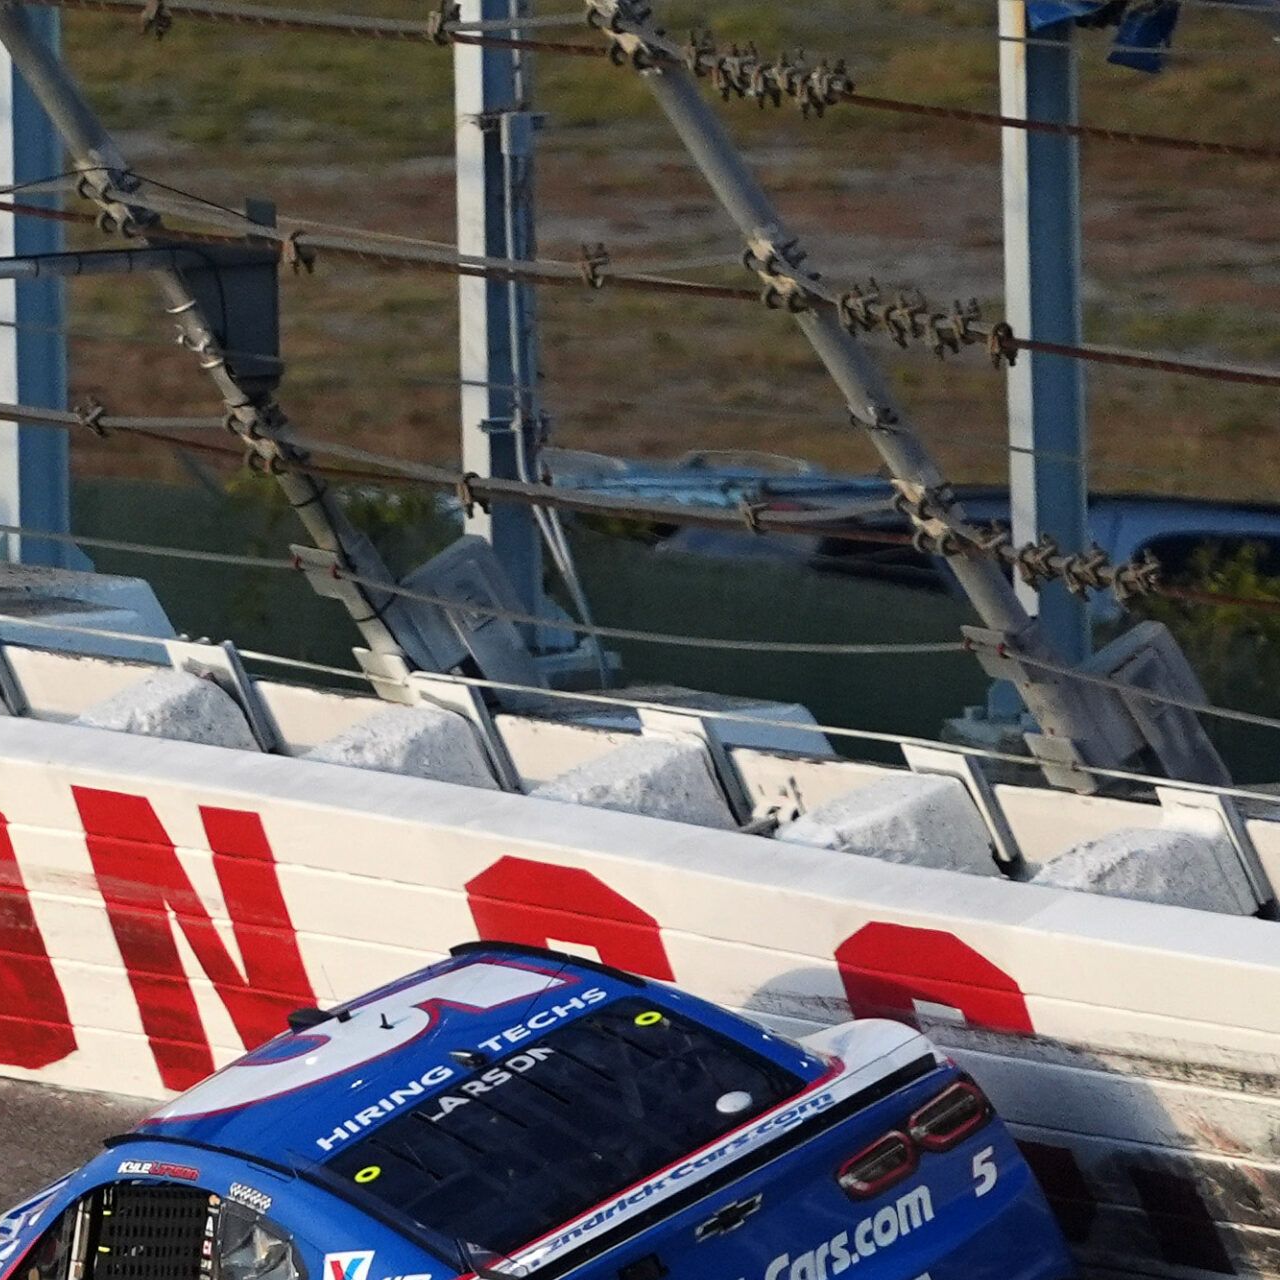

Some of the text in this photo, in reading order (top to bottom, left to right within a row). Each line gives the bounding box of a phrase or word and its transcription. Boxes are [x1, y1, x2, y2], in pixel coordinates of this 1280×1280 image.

[316, 987, 609, 1151] HIRING TECHS
[971, 1144, 999, 1198] 5
